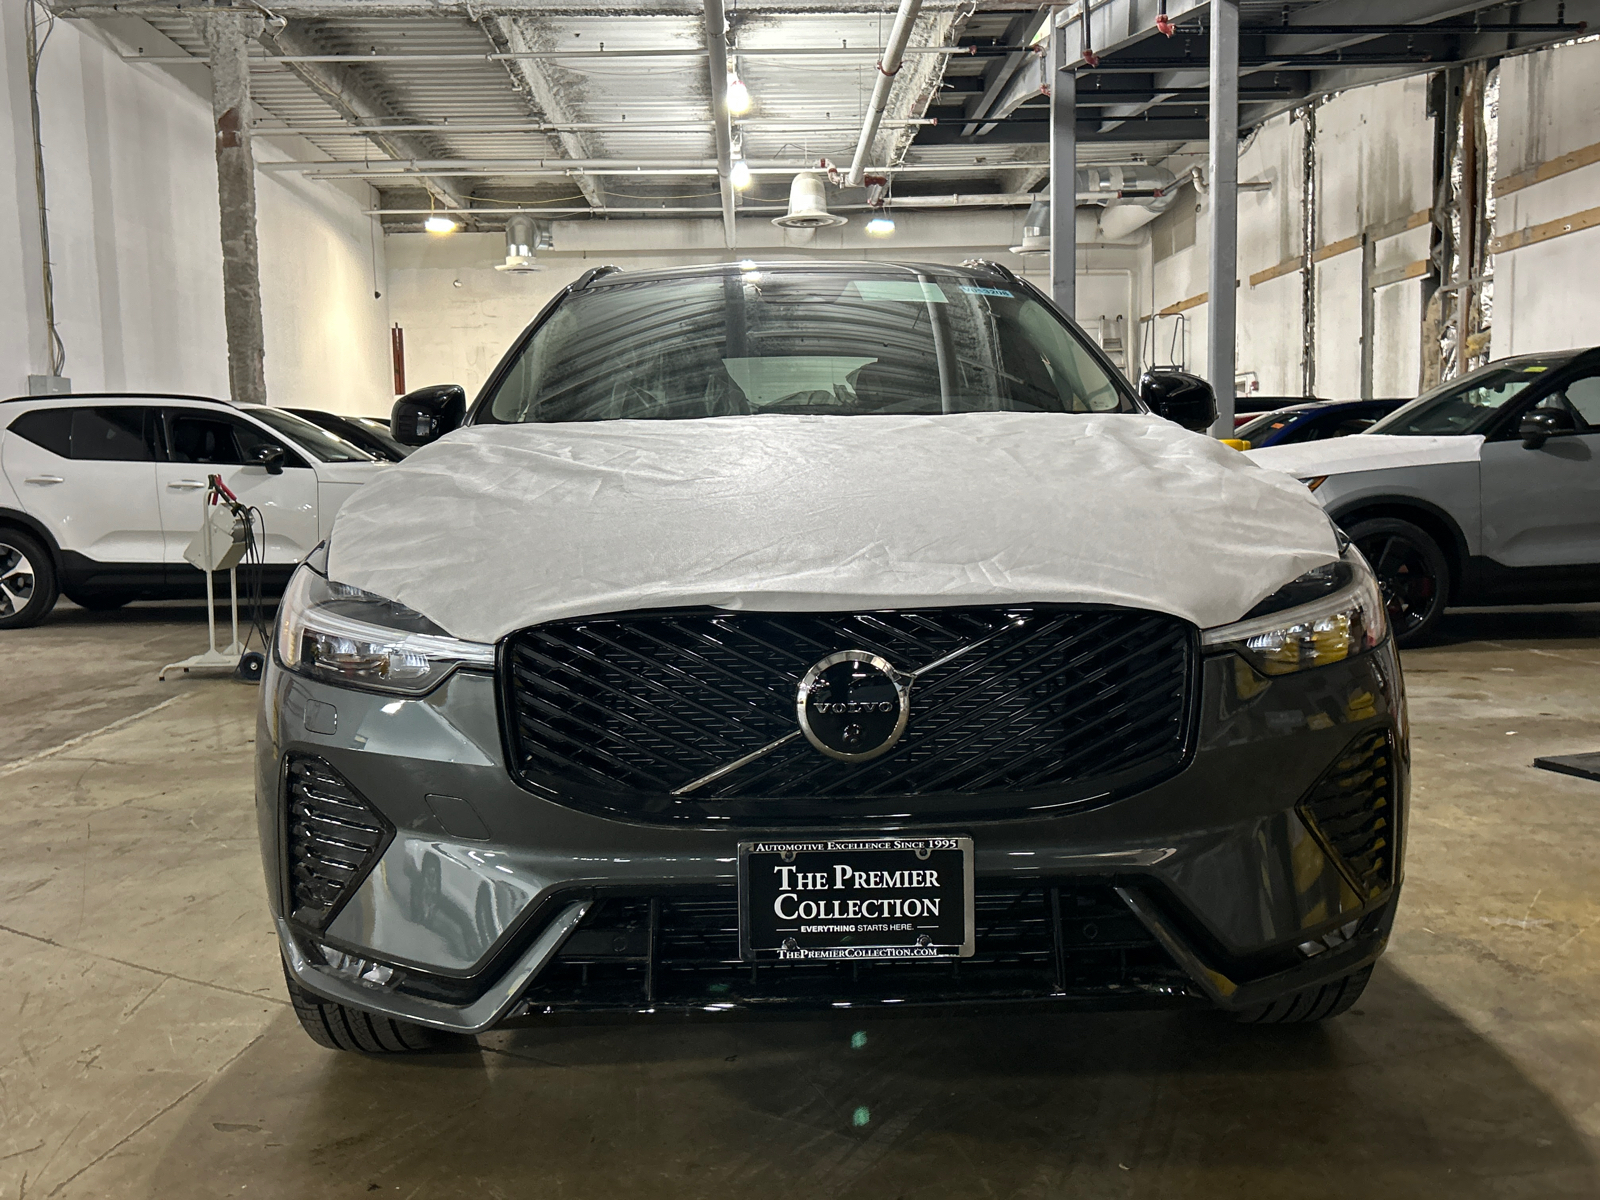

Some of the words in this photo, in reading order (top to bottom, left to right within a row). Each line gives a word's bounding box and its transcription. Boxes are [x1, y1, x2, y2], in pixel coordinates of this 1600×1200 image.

[813, 701, 893, 713] VOLVO
[756, 843, 824, 852] AUTOMOTIVE
[827, 841, 891, 850] EXCELLENCE
[893, 840, 925, 849] SINCE
[928, 839, 957, 848] 1995
[774, 865, 829, 891] THE
[833, 865, 940, 889] PREMIER
[774, 893, 941, 920] COLLECTION
[801, 925, 856, 933] EVERYTHING
[857, 924, 888, 932] STARTS
[889, 923, 914, 931] HERE.
[777, 948, 938, 959] THEPREMIERCOLLECTION.COM
